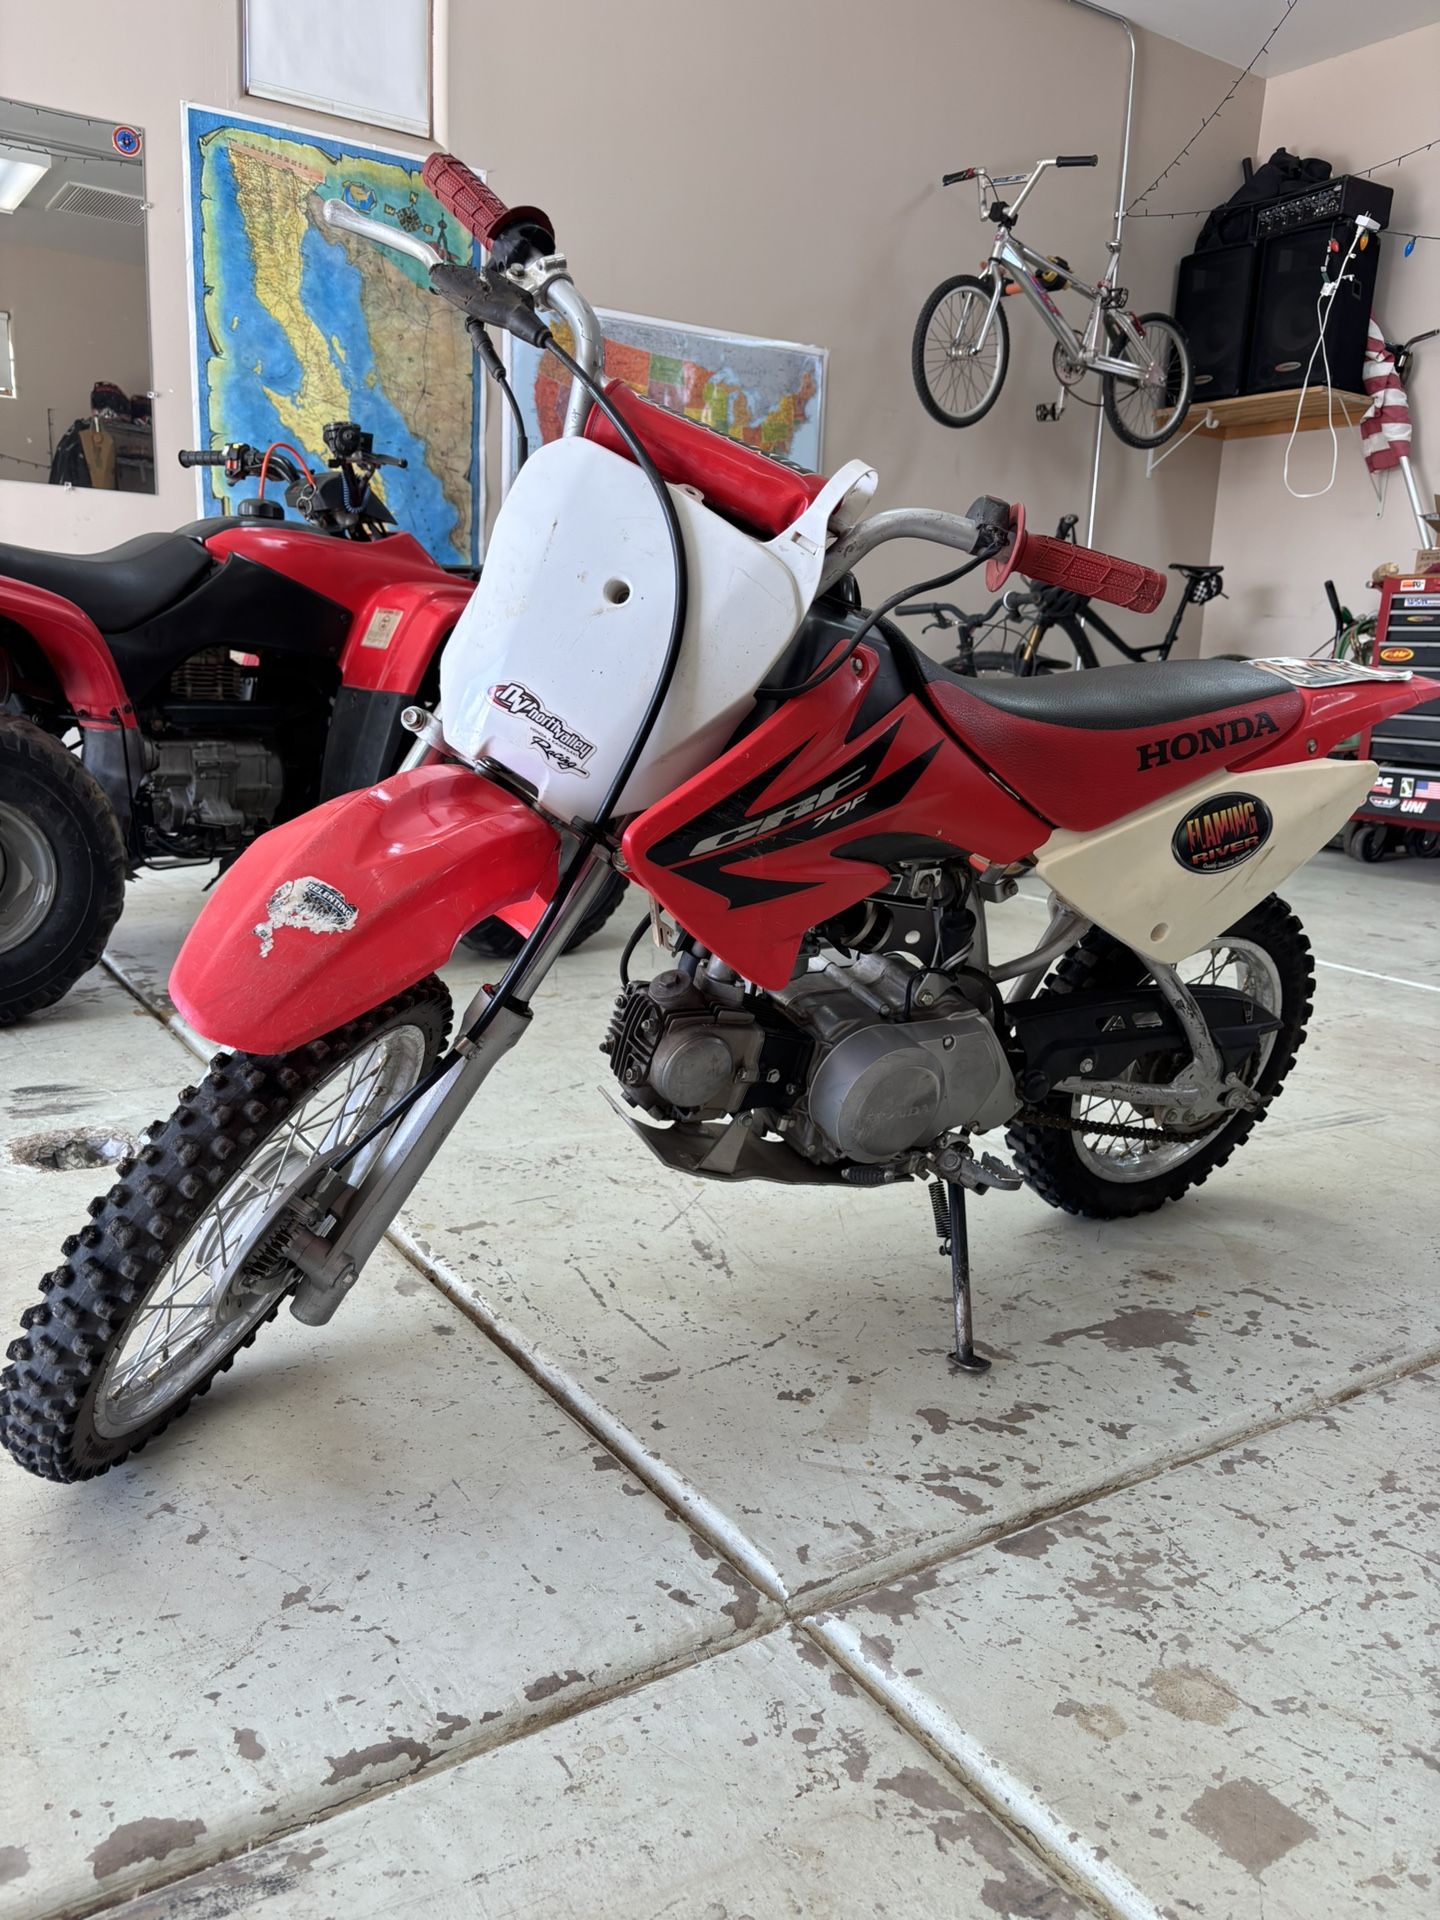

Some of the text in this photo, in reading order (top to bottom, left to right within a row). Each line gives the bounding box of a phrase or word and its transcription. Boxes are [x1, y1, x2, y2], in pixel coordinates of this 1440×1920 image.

[530, 736, 587, 775] Racing
[1136, 711, 1280, 772] HONDA
[689, 765, 867, 857] CRF
[811, 792, 868, 830] 70F
[1400, 800, 1428, 814] UNI
[1187, 801, 1259, 853] FLAMING
[1191, 836, 1260, 865] RIVER
